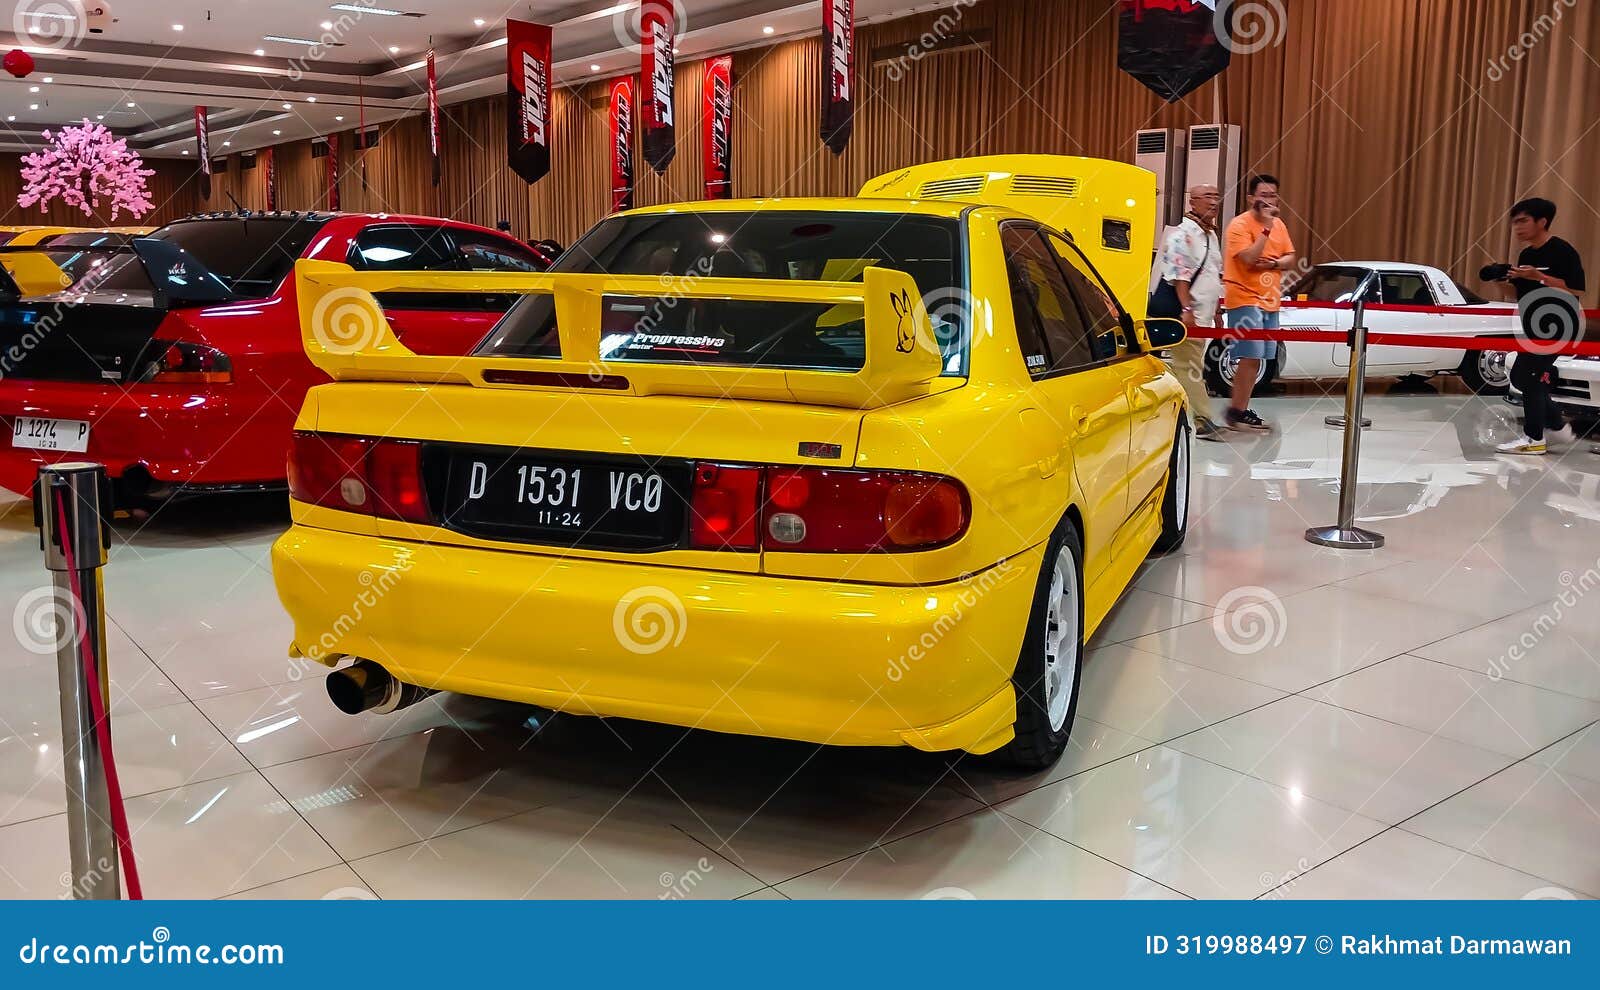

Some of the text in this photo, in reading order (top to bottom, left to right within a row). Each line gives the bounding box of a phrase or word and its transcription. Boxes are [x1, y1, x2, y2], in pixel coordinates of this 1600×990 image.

[15, 419, 87, 440] D 1274 P
[469, 461, 487, 499] D
[517, 465, 581, 507] 1531
